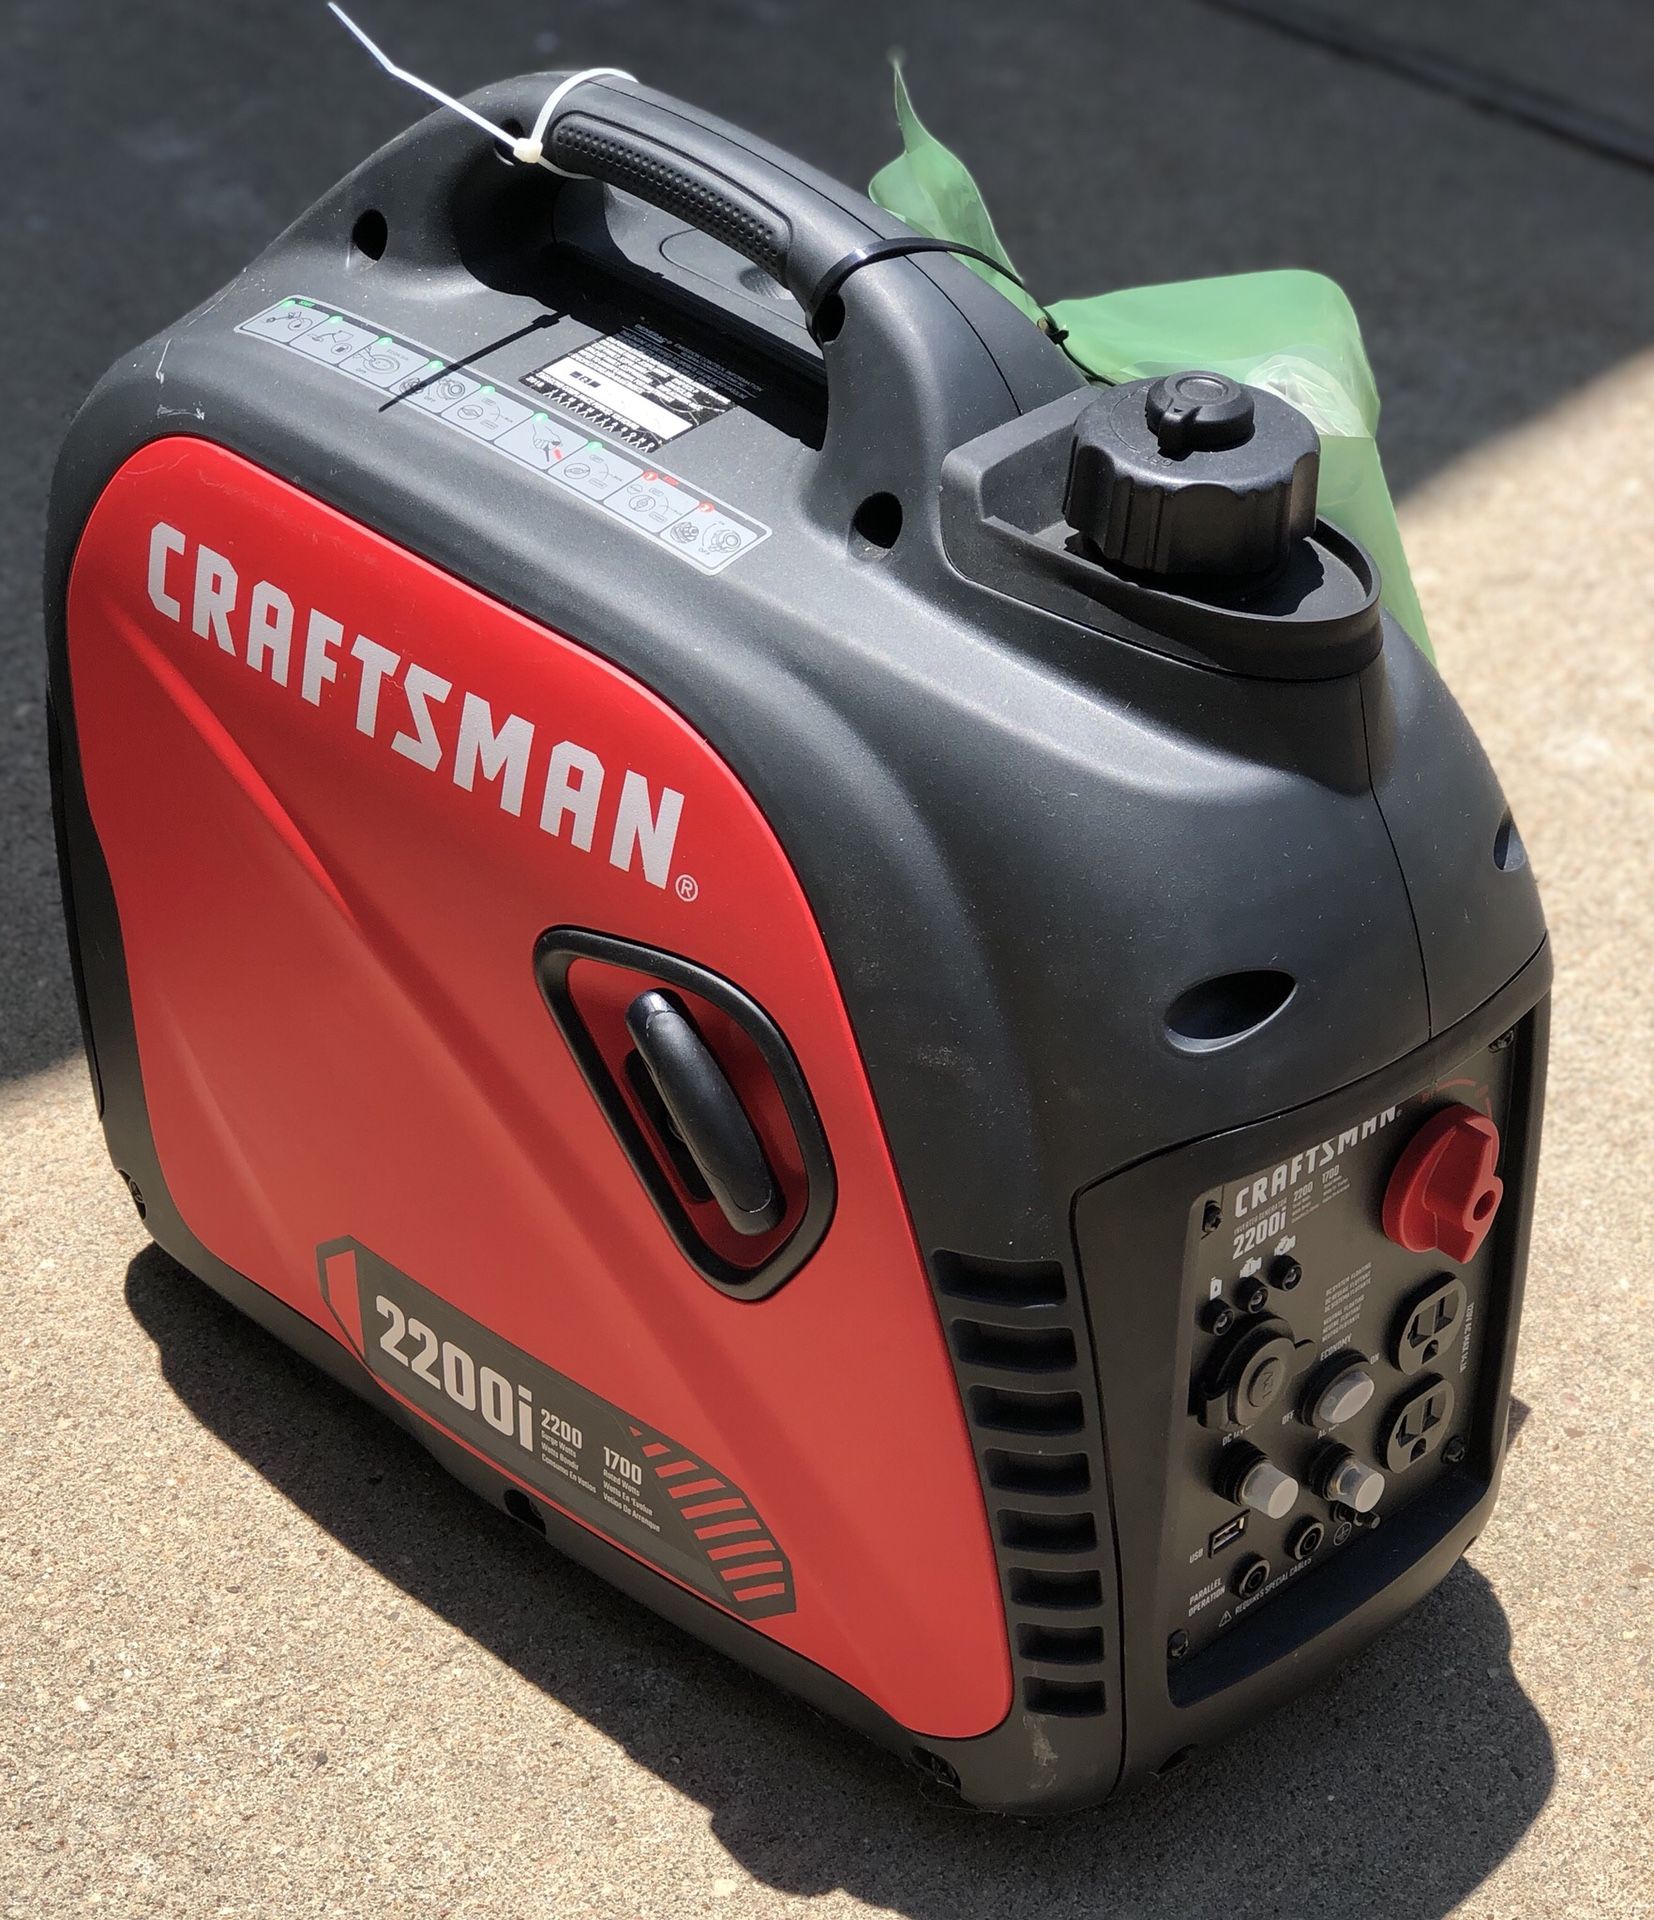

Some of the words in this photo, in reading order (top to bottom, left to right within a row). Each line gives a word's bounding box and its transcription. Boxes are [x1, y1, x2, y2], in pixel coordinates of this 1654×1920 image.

[147, 521, 685, 890] CRAFTSMAN
[1235, 1105, 1396, 1218] CRAFTSMAN
[1322, 1164, 1340, 1184] 1700
[1293, 1181, 1313, 1202] 2200
[1233, 1205, 1287, 1260] 2200i
[1320, 1333, 1352, 1361] ECONOMY
[376, 1295, 533, 1452] 2200i
[541, 1408, 582, 1449] 2200
[603, 1445, 642, 1485] 1700
[1189, 1548, 1204, 1564] USB
[1189, 1578, 1222, 1605] PARALLEL
[1264, 1572, 1289, 1594] SPECIAL
[1188, 1585, 1226, 1617] OPERATION
